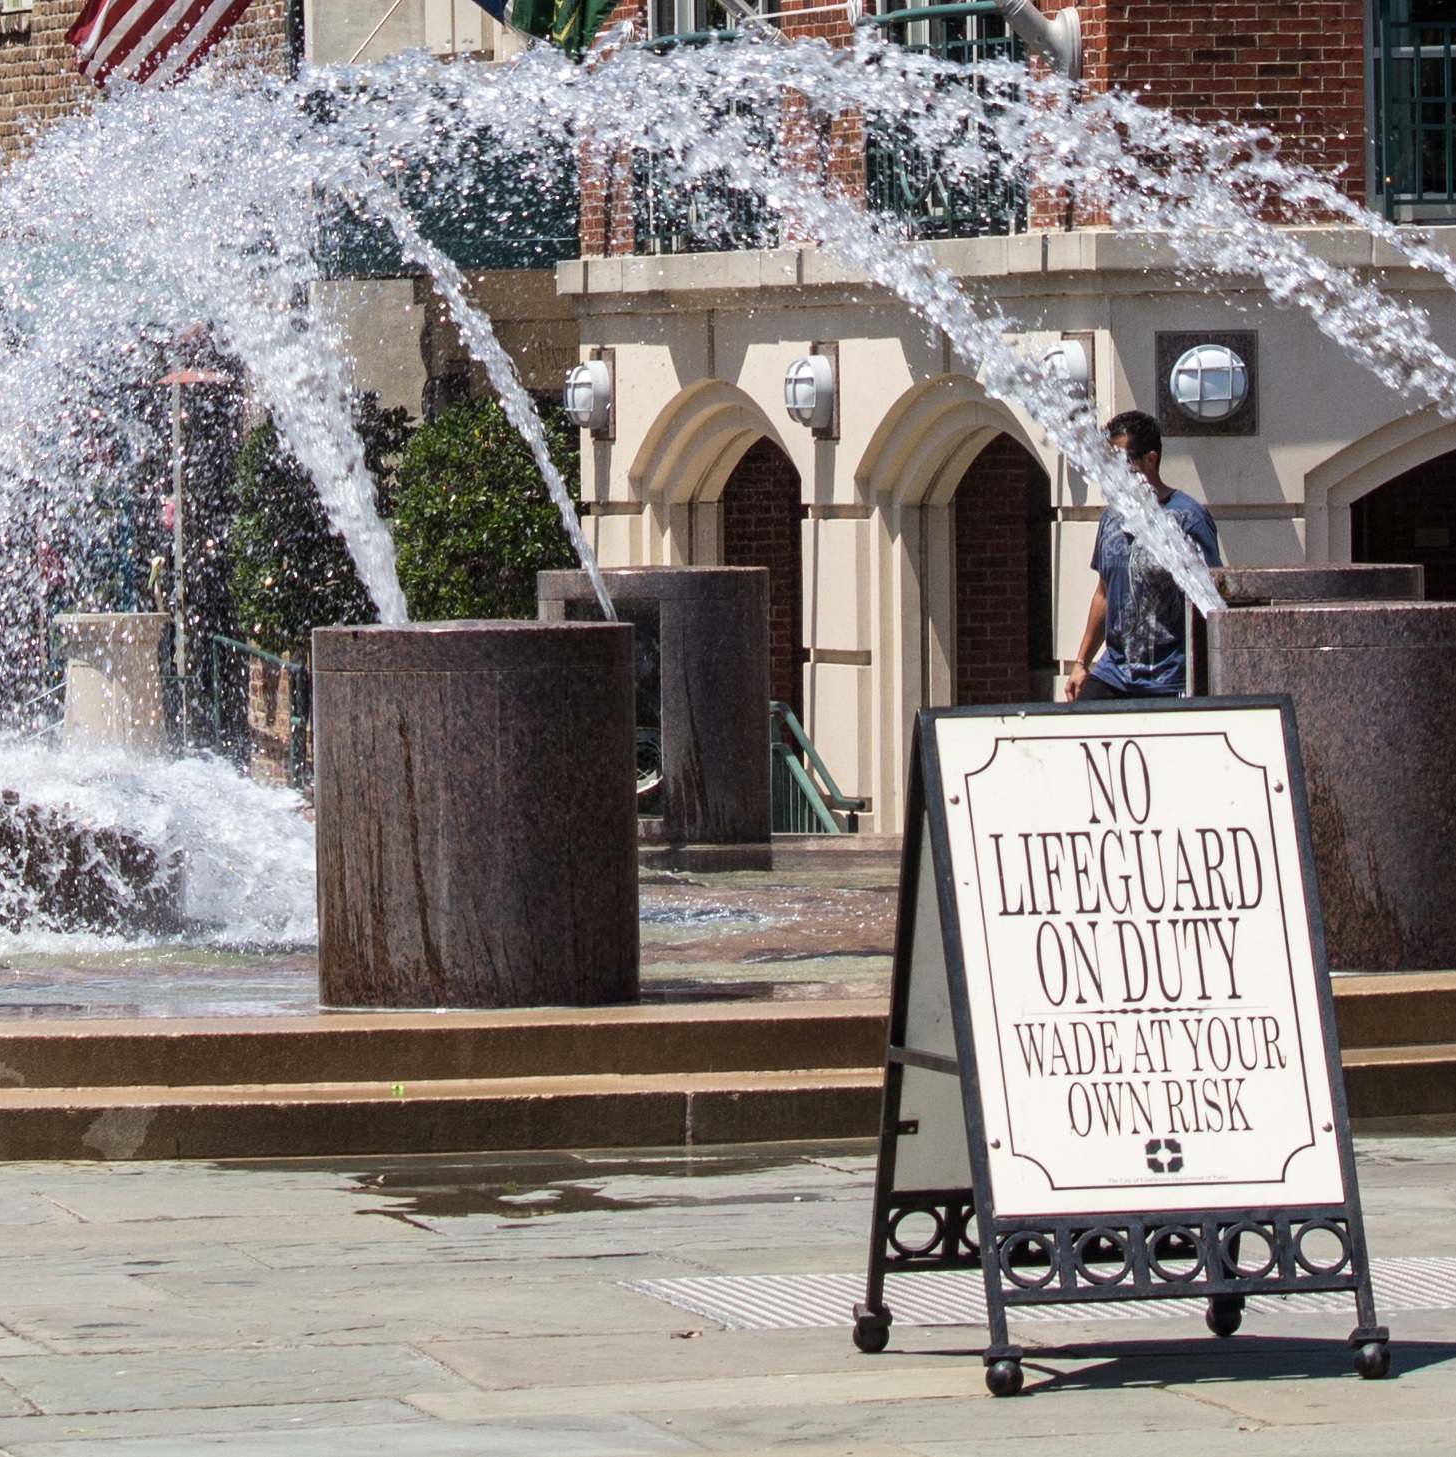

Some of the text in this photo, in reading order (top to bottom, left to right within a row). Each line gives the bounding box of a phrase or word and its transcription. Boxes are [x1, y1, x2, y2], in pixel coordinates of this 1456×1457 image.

[1080, 740, 1151, 825] NO
[989, 827, 1263, 917] LIFEGUARD
[1037, 917, 1242, 1007] ON DUTY
[1013, 1016, 1287, 1077] WADE AT YOUR
[1068, 1078, 1253, 1137] OWN RISK
